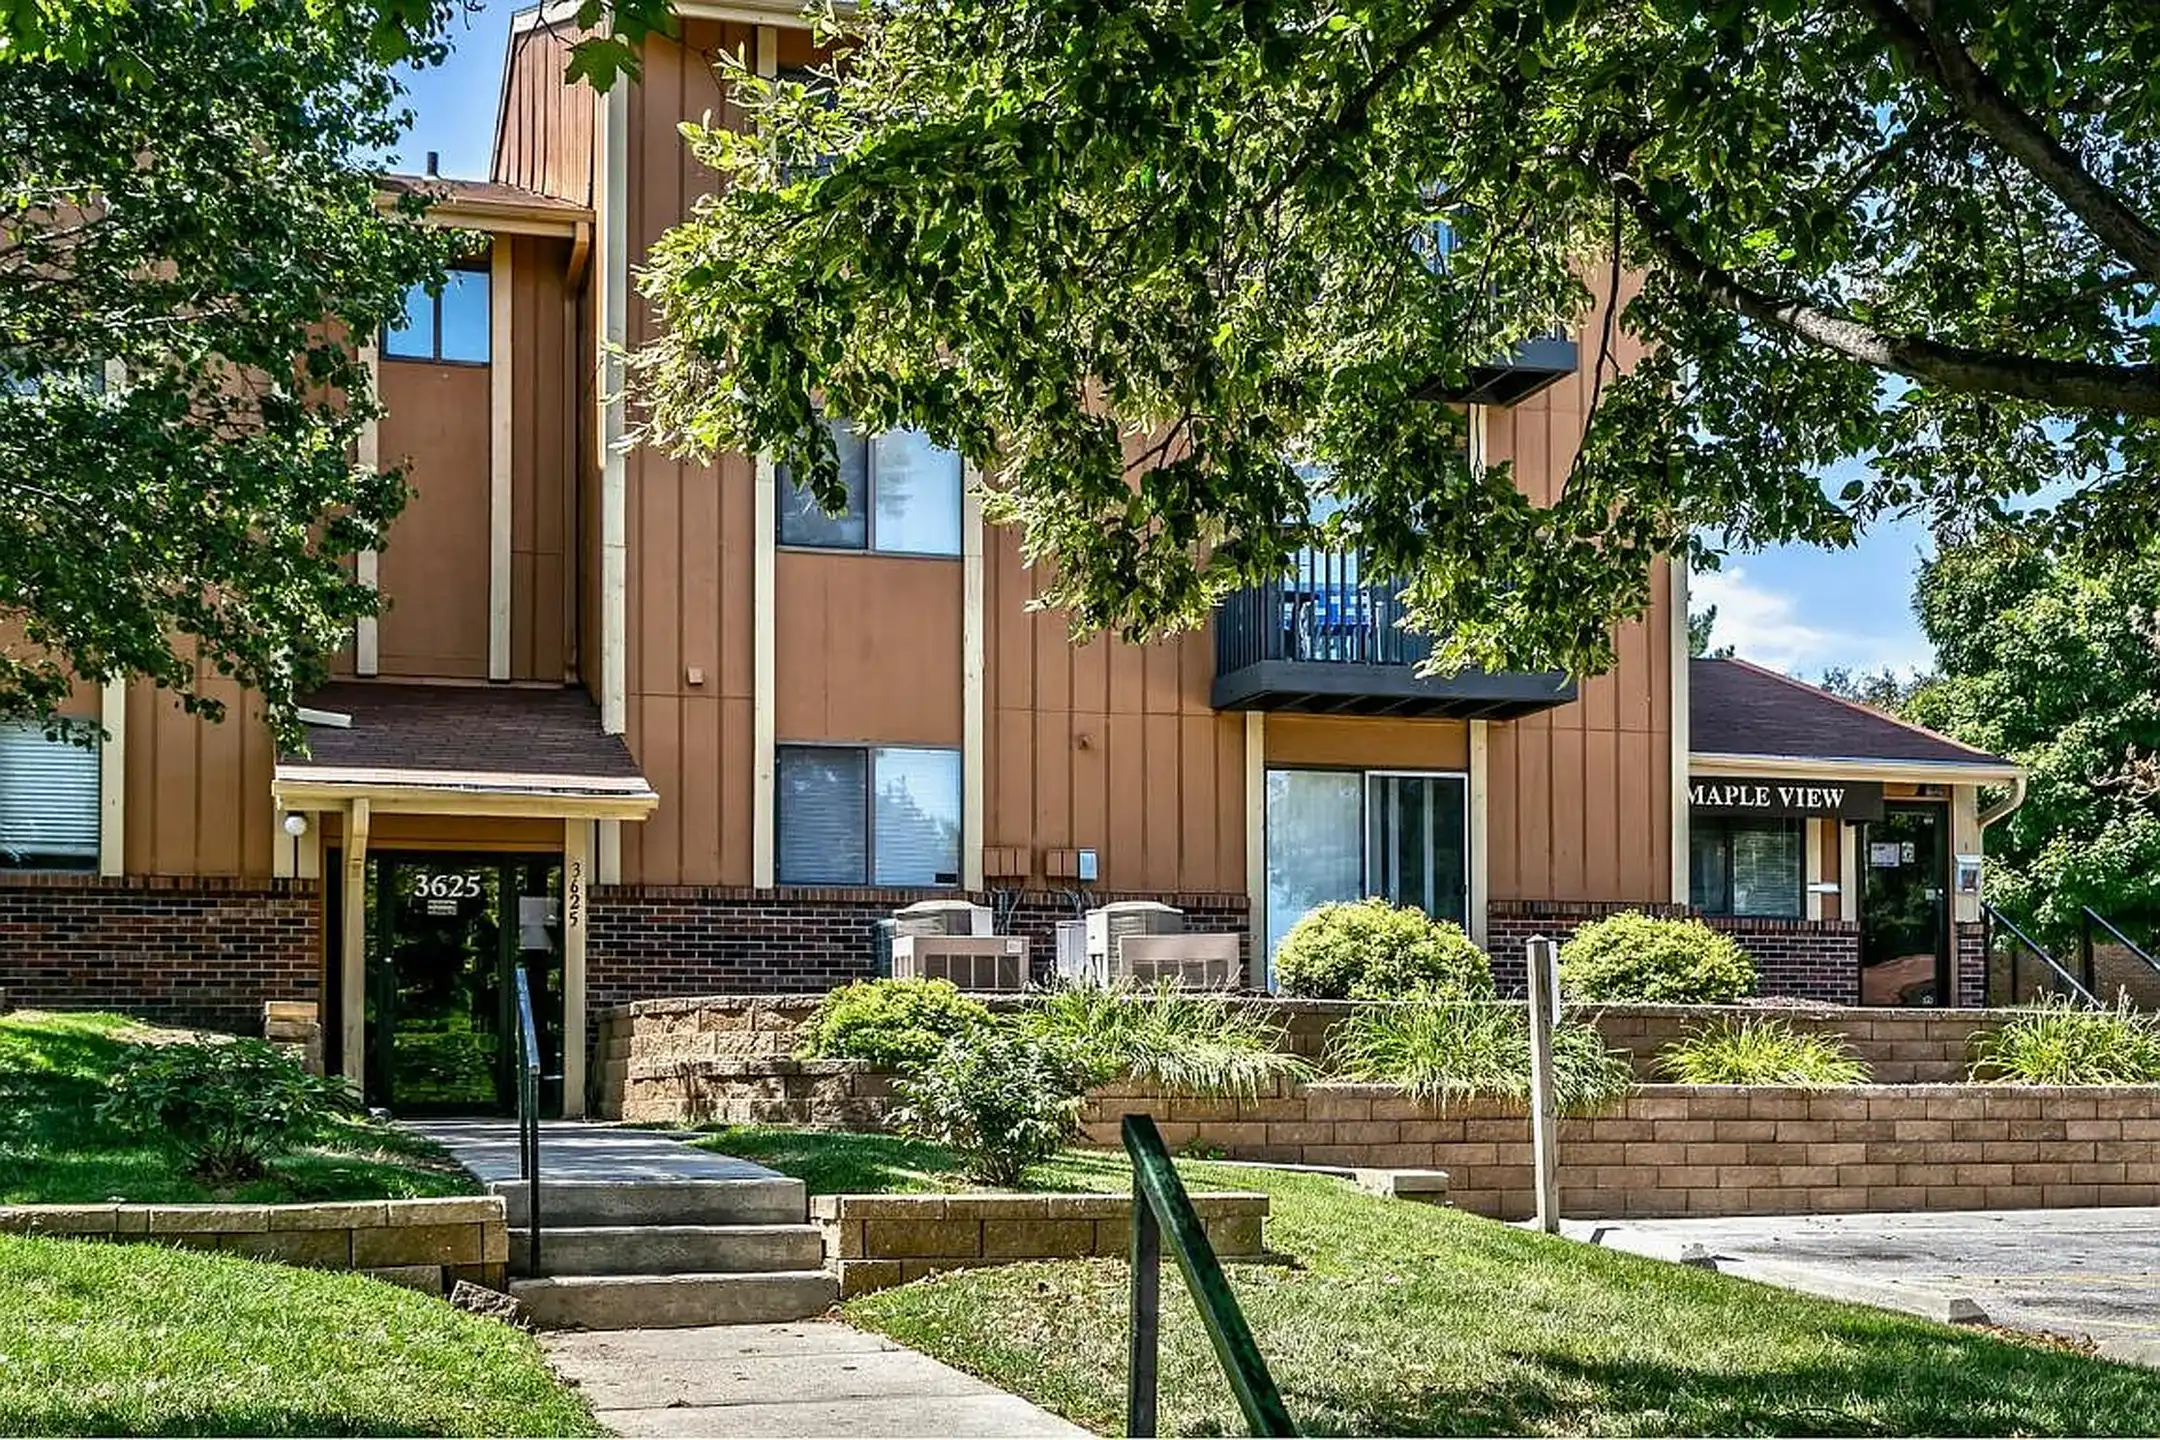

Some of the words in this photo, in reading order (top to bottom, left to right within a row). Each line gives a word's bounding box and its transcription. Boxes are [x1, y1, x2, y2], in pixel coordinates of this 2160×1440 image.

[1687, 784, 1771, 807] MAPLE
[1778, 786, 1845, 809] VIEW
[413, 874, 481, 898] 3625
[569, 861, 581, 928] 3625
